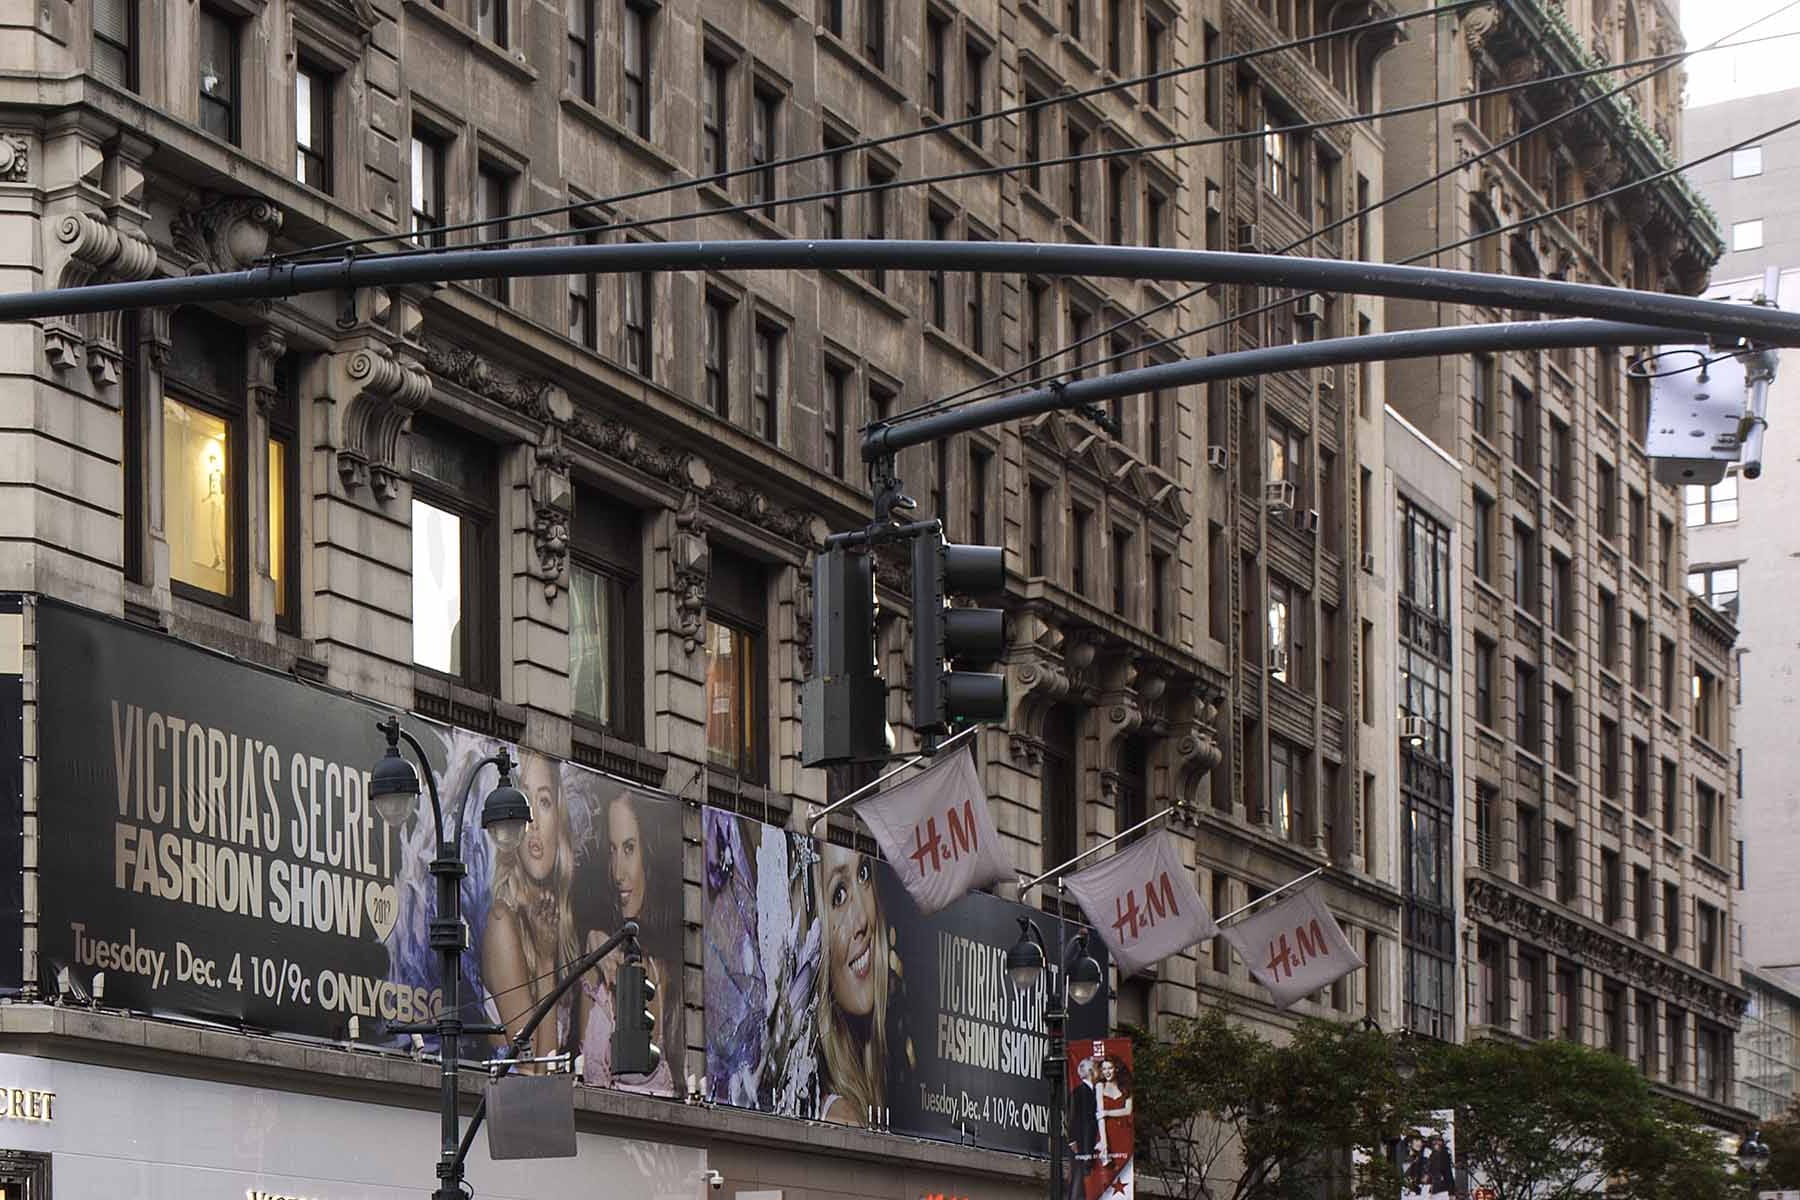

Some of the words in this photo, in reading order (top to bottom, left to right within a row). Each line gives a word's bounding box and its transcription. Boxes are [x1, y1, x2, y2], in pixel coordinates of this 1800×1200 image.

[111, 700, 280, 852] VICTORIA'S
[910, 800, 978, 877] H&M
[115, 822, 262, 918] FASHION
[269, 860, 364, 939] SHOW
[1112, 872, 1179, 944] H&M
[71, 922, 169, 987] Tuesday,
[176, 941, 222, 988] Dec.
[227, 952, 243, 991] 4
[251, 955, 311, 1005] 10/9c
[938, 930, 1008, 1025] VICTORIA'S
[1266, 919, 1328, 983] H&M
[937, 1014, 999, 1071] FASHION
[1001, 1029, 1042, 1080] SHOW
[920, 1081, 959, 1123] Tuesday,
[961, 1091, 981, 1122] Dec.
[983, 1096, 990, 1122] 4
[993, 1095, 1019, 1129] 10/9c
